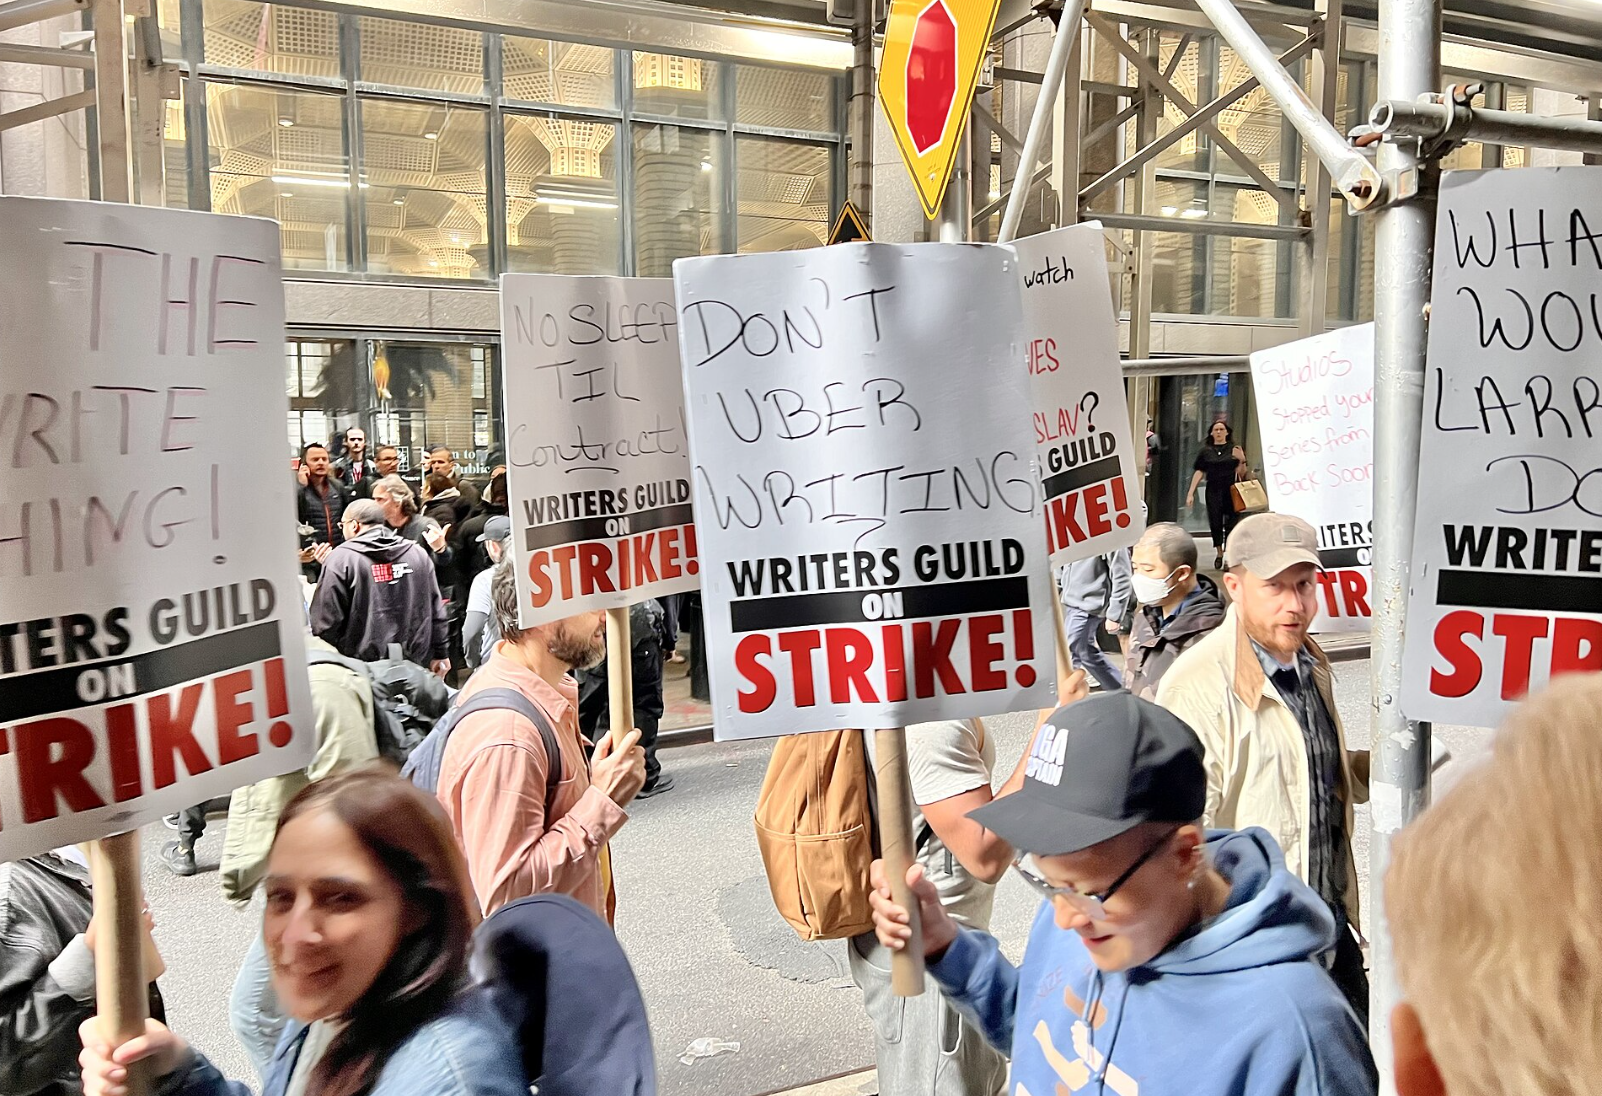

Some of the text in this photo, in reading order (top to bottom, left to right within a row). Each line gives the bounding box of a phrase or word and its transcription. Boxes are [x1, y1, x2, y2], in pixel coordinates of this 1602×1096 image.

[1023, 256, 1074, 289] watch
[63, 241, 266, 356] THE
[682, 276, 896, 367] DON'T
[567, 300, 678, 345] SLEEP
[533, 358, 641, 403] TIL
[716, 377, 921, 443] UBER
[1271, 386, 1374, 431] Stopped your
[463, 449, 476, 460] to
[508, 406, 689, 467] Contract!
[1047, 431, 1117, 473] GUILD
[1324, 426, 1370, 451] from
[523, 478, 690, 526] WRITERS GUILD
[695, 450, 1036, 530] WRITING
[1273, 470, 1320, 496] Back
[604, 516, 631, 537] ON
[528, 524, 700, 608] STRIKE!
[726, 537, 1026, 597] WRITERS GUILD
[148, 577, 277, 645] GUILD
[861, 591, 905, 621] ON
[76, 662, 137, 703] ON
[734, 608, 1038, 714] STRIKE!
[0, 657, 293, 831] RIKE!
